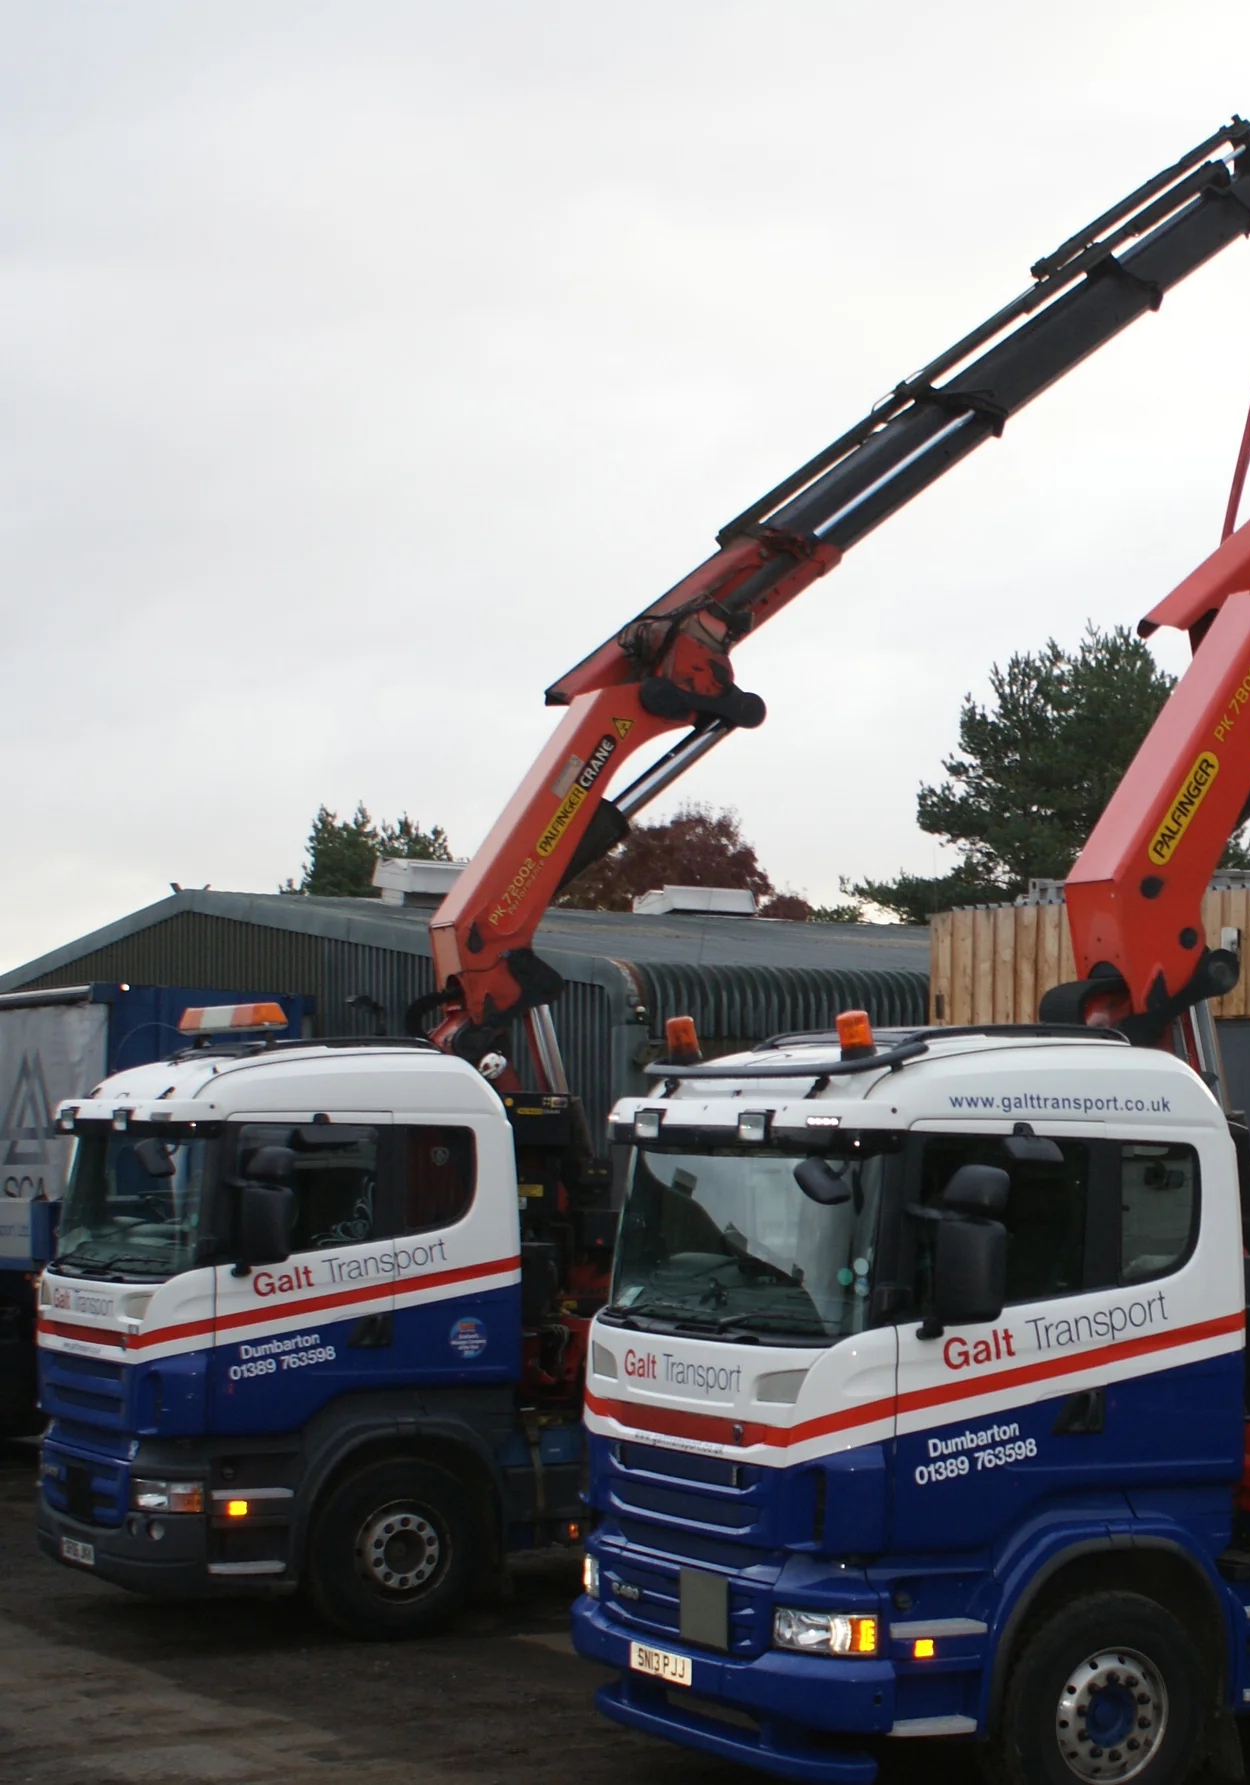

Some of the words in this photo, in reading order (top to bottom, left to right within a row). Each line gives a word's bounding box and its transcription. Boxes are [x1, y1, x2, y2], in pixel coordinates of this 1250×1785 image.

[1214, 714, 1234, 742] PK
[539, 786, 585, 853] PALFINGER
[580, 739, 614, 788] CRANE
[1153, 758, 1216, 859] PALFINGER
[489, 906, 507, 926] PK
[502, 857, 536, 904] 72002
[949, 1093, 1172, 1114] www.galttransport.co.uk
[252, 1265, 315, 1298] Galt
[322, 1237, 448, 1284] Transport
[239, 1333, 321, 1360] Dumbarton
[943, 1328, 1016, 1370] Galt
[1025, 1291, 1168, 1350] Transport
[229, 1357, 277, 1381] 01389
[281, 1346, 336, 1370] 763598
[624, 1348, 657, 1379] Galt
[662, 1352, 742, 1395] Transport
[915, 1455, 970, 1485] 01389
[973, 1438, 1038, 1471] 763598
[927, 1422, 1020, 1458] Dumbarton
[638, 1647, 660, 1672] SN13
[663, 1654, 686, 1679] PJJ
